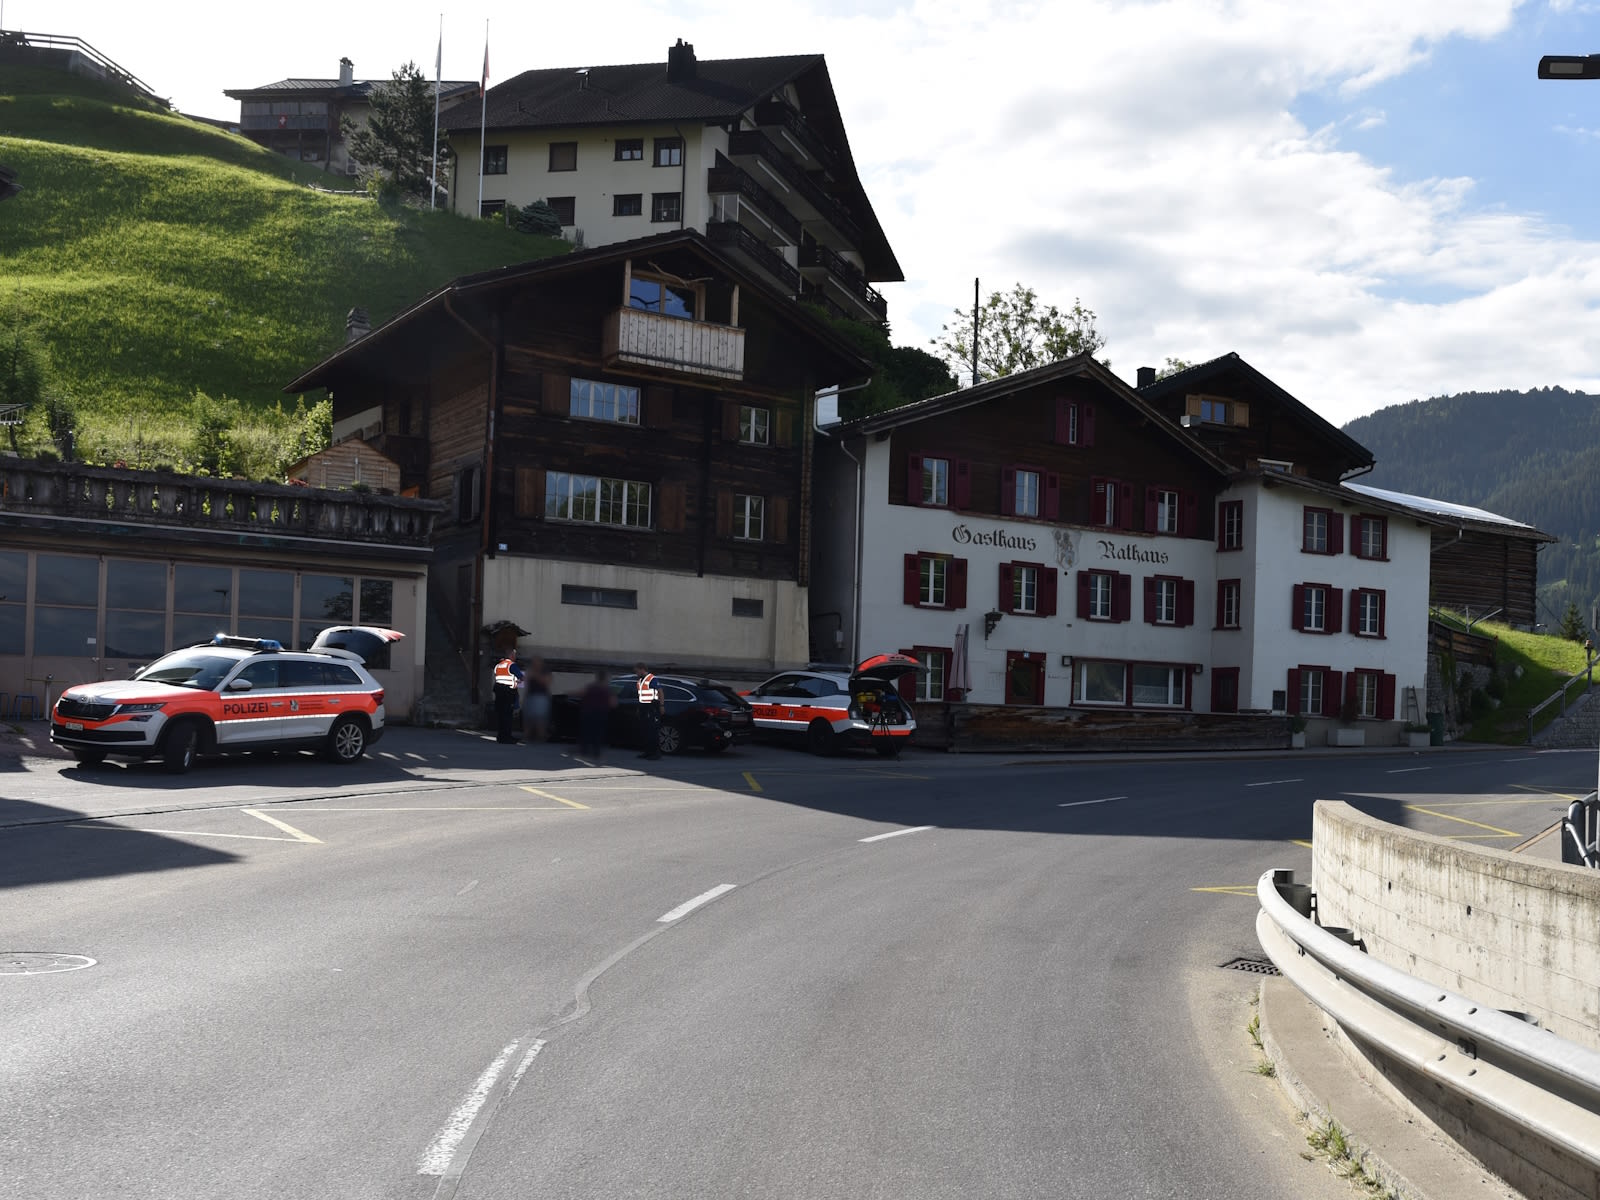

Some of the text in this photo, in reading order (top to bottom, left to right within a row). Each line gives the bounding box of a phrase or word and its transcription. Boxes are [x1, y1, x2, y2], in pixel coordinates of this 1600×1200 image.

[952, 524, 1169, 565] Gasthaus Rathaus
[223, 702, 269, 715] POLIZEI
